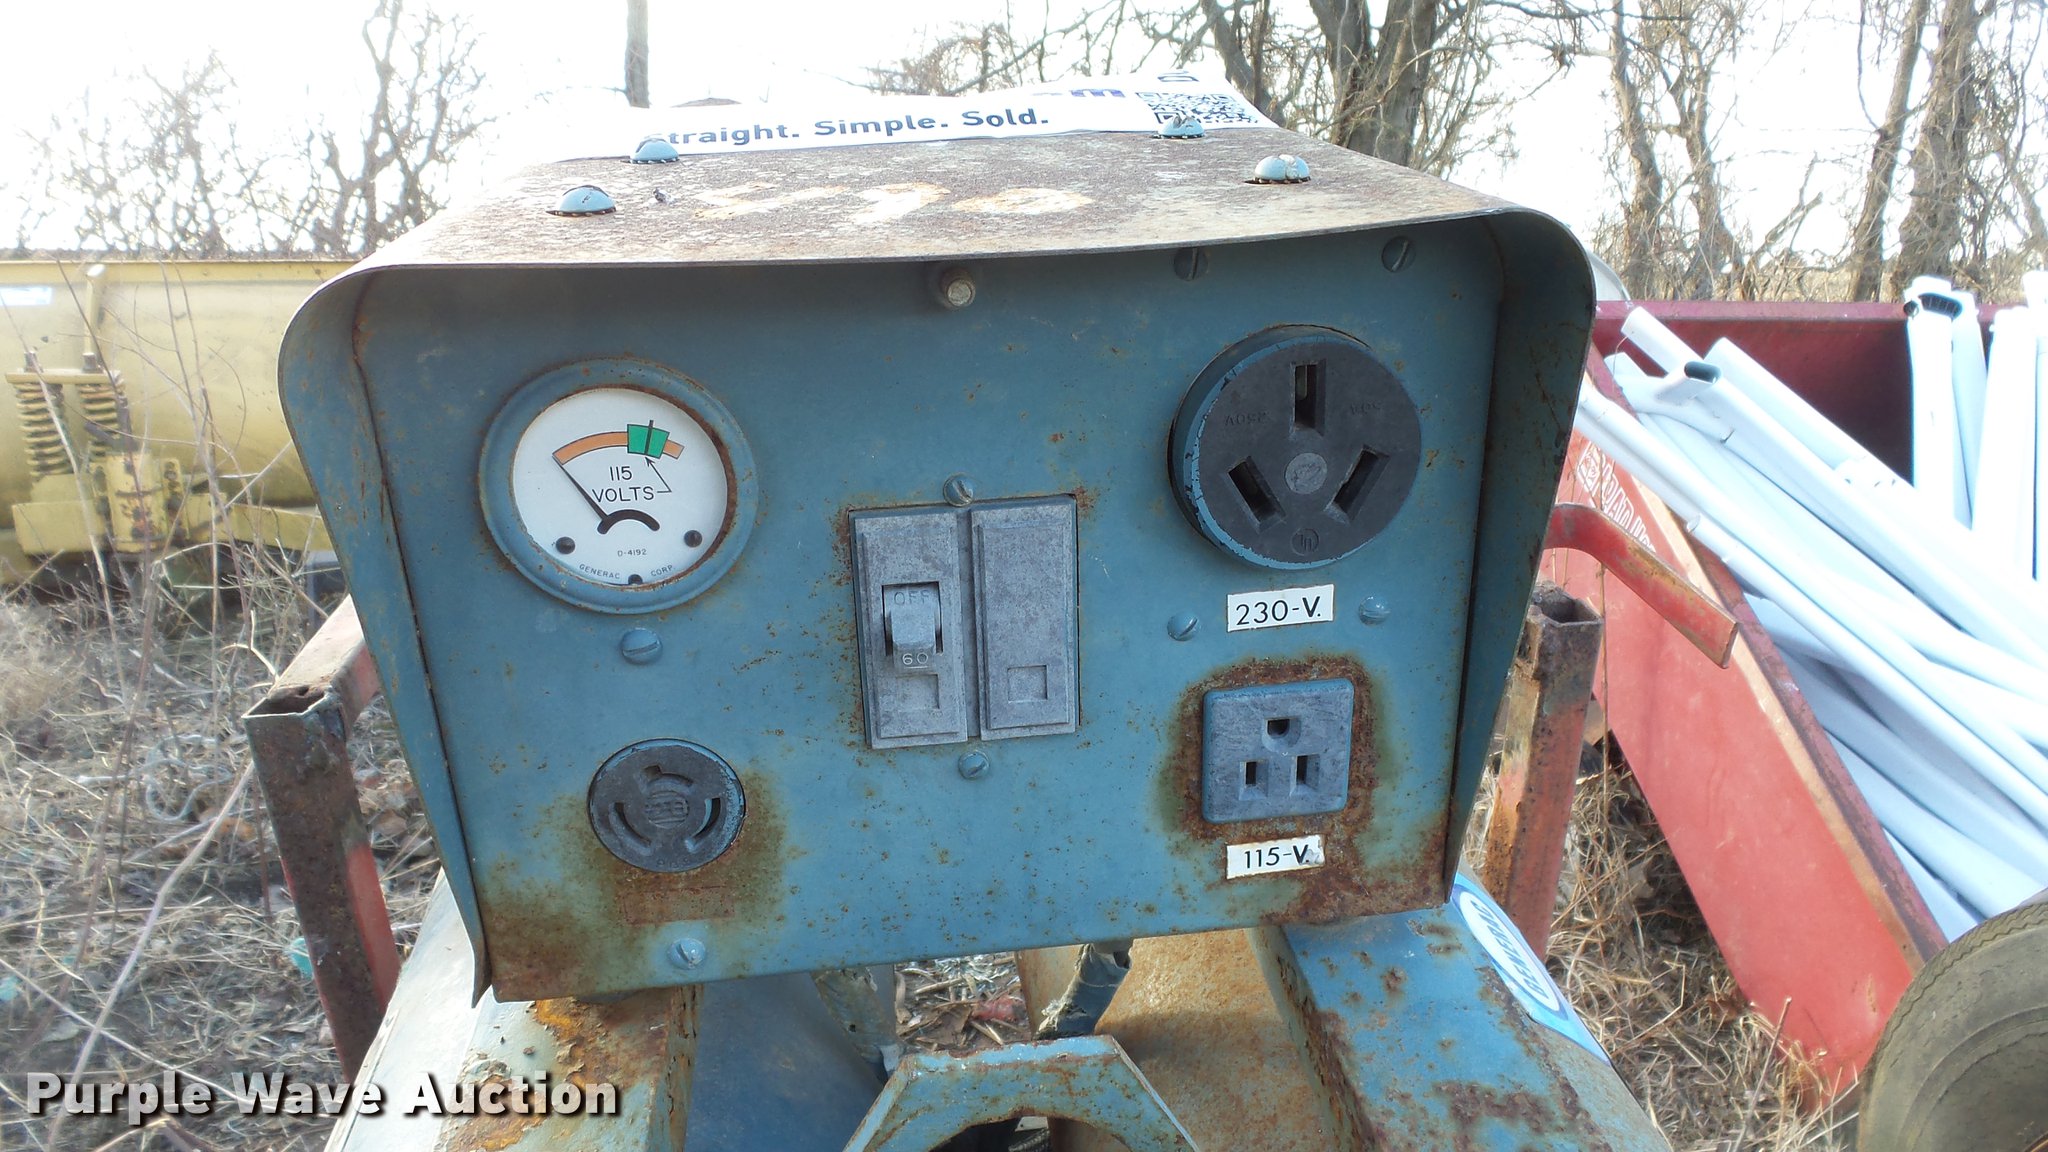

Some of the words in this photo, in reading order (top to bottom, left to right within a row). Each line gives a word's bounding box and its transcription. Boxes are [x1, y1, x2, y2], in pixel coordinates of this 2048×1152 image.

[645, 124, 799, 146] traight.
[814, 114, 948, 136] Simple.
[962, 108, 1048, 127] Sold.
[609, 466, 633, 482] 115
[592, 486, 655, 503] VOLTS
[579, 564, 621, 579] GENERAC
[894, 589, 930, 606] OFF
[1235, 596, 1321, 626] 230-V.
[902, 653, 929, 665] 60
